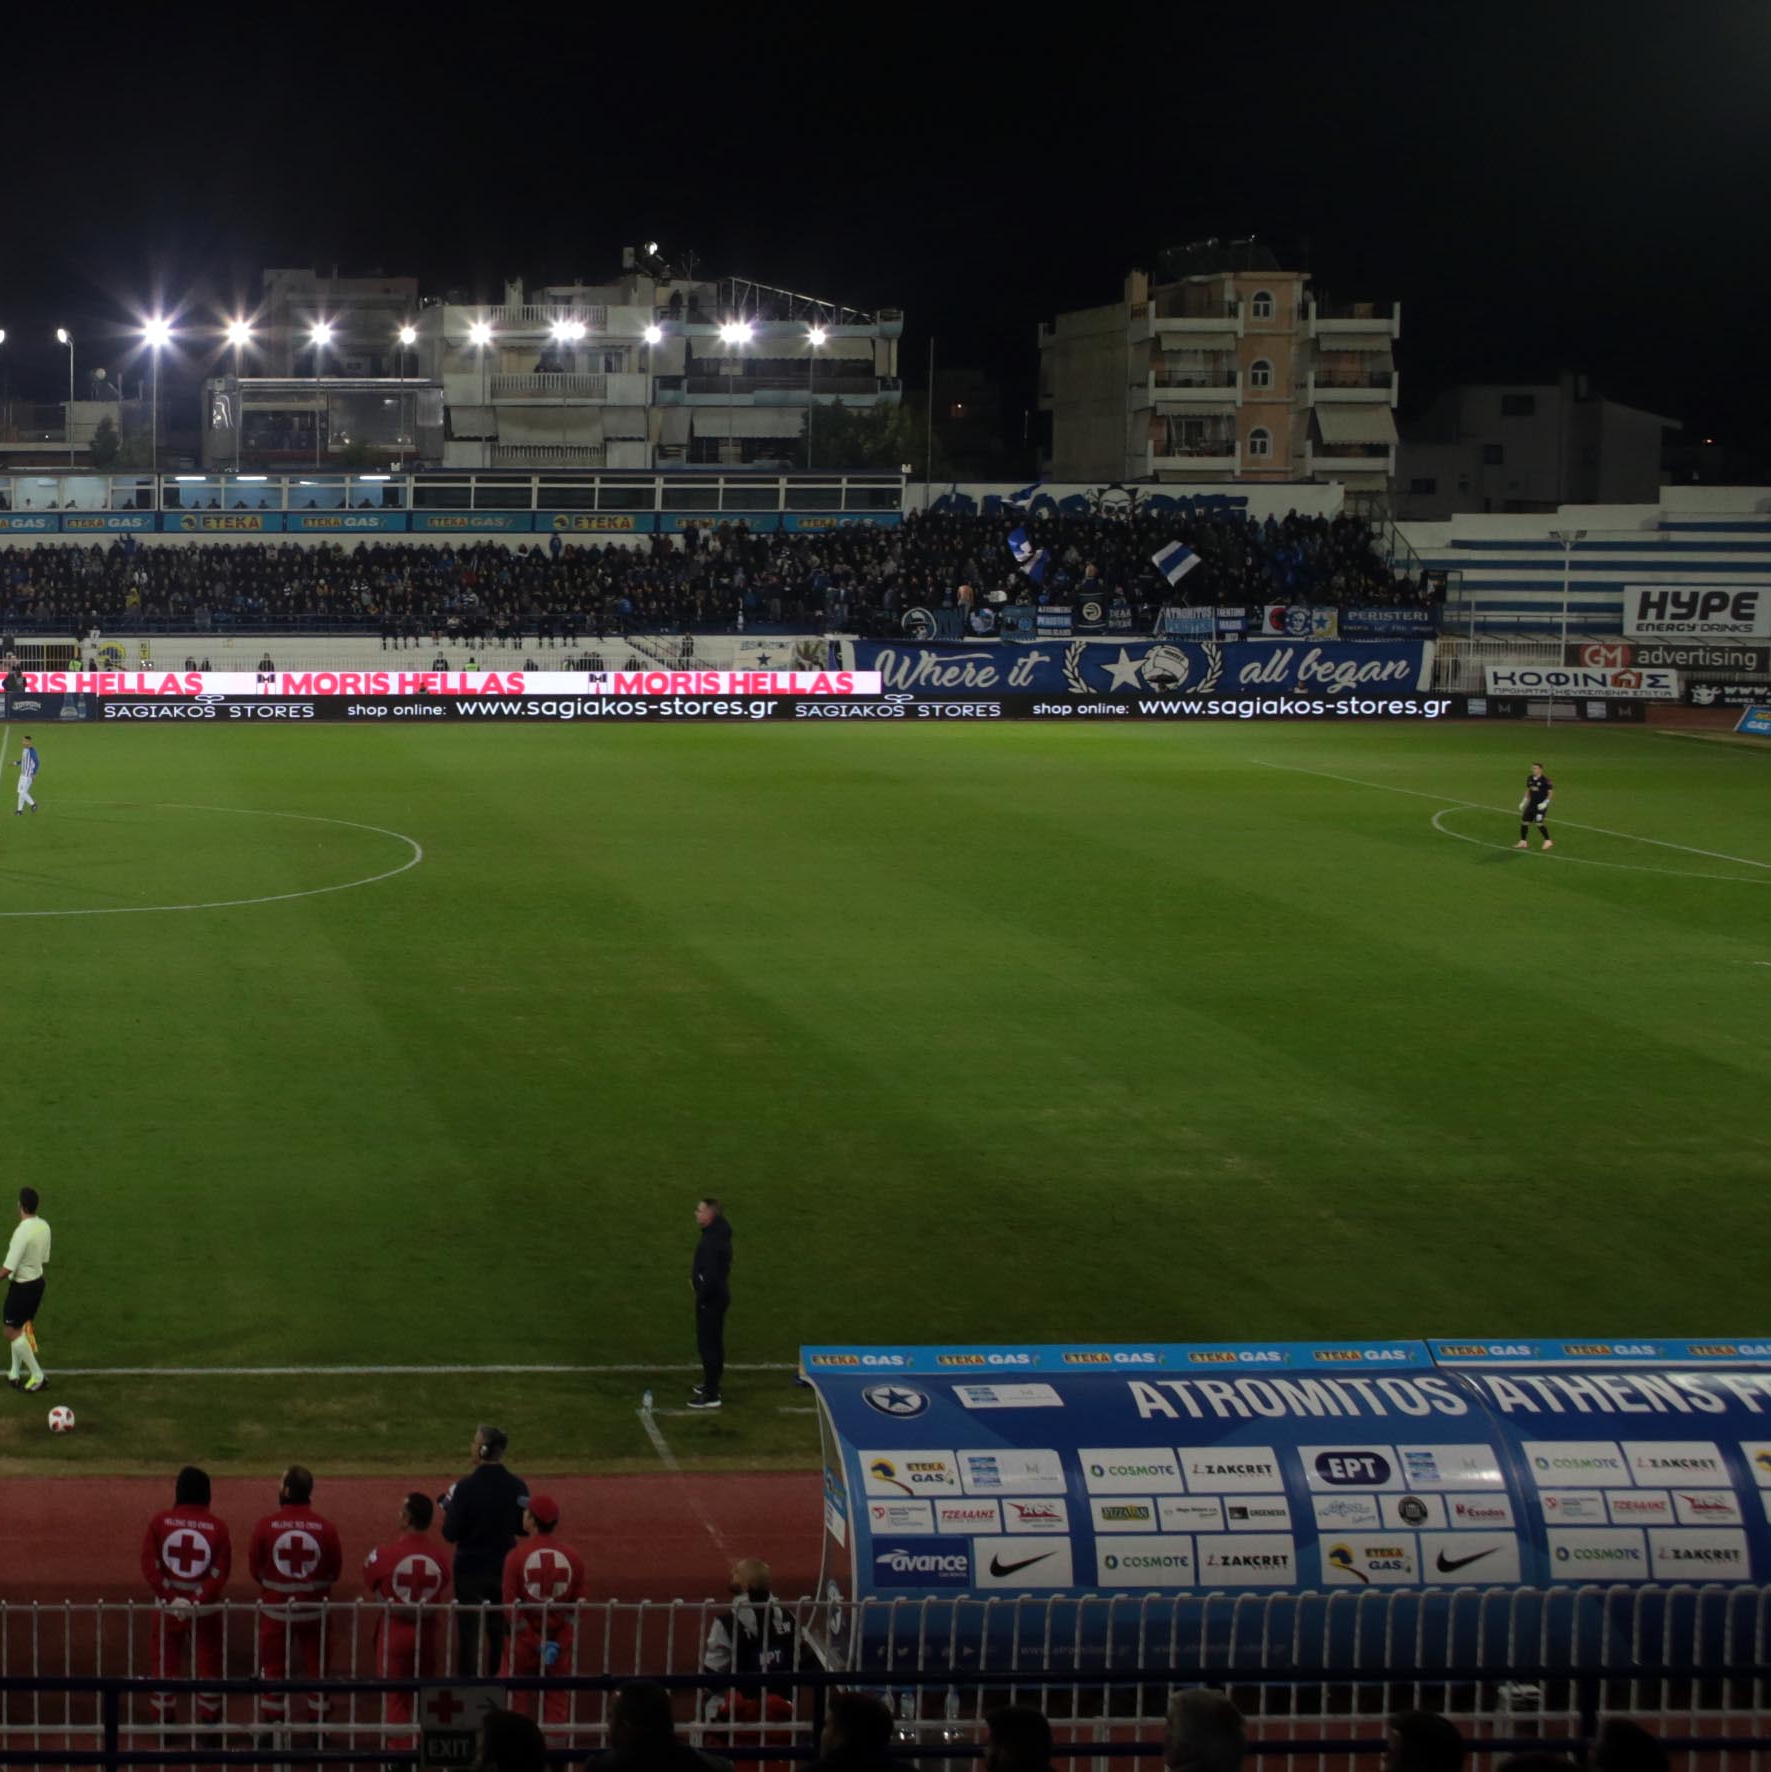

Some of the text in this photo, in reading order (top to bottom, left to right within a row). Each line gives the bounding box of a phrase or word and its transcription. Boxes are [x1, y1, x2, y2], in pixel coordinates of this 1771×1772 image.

[11, 517, 46, 529] GAS
[67, 517, 143, 528] ETEKA GAS
[201, 516, 262, 529] ETEKA
[302, 516, 379, 527] ETEKA GAS
[428, 517, 506, 527] ETEKA GAS
[574, 515, 634, 529] ETEKA
[1637, 591, 1759, 621] HYPE
[1348, 611, 1429, 621] PERISTERI
[1636, 623, 1753, 632] ENERGY DRINKS
[1637, 646, 1757, 671] advertising
[875, 645, 1411, 693] Where it all began
[76, 672, 204, 695] HELLAS
[283, 672, 526, 695] MORIS HELLAS
[614, 672, 855, 694] MORIS HELLAS
[104, 705, 315, 718] SAGIAKOS STORES
[348, 697, 777, 719] shop online: www.sagiakos-stores.gr
[795, 704, 1001, 717] SAGIAKOS STORES
[1033, 696, 1452, 718] shop online: www.sagiakos-stores.gr
[1315, 1350, 1406, 1361] ETEKA GAS
[1439, 1345, 1531, 1356] ETEKA GAS
[1563, 1345, 1655, 1356] ETEKA GAS
[811, 1354, 905, 1366] ETEKA GAS
[938, 1353, 1030, 1365] ETEKA GAS
[1063, 1352, 1156, 1364] ETEKA GAS
[1190, 1351, 1281, 1363] ETEKA GAS
[1128, 1374, 1727, 1418] ATROMITOS ATHENS
[906, 1462, 946, 1472] ETEKA
[1109, 1465, 1175, 1475] COSMOTE
[1204, 1463, 1272, 1474] ZAKCRET
[1328, 1458, 1376, 1479] ΕΡΤ
[911, 1474, 945, 1483] GAS
[1365, 1548, 1404, 1558] ETEKA
[1573, 1548, 1641, 1559] COSMOTE
[1673, 1549, 1741, 1560] ZAKCRET
[892, 1552, 967, 1571] avance
[1123, 1556, 1189, 1567] COSMOTE
[1220, 1555, 1288, 1567] ZAKCRET
[1369, 1560, 1403, 1570] GAS
[428, 1739, 469, 1758] EXIT
